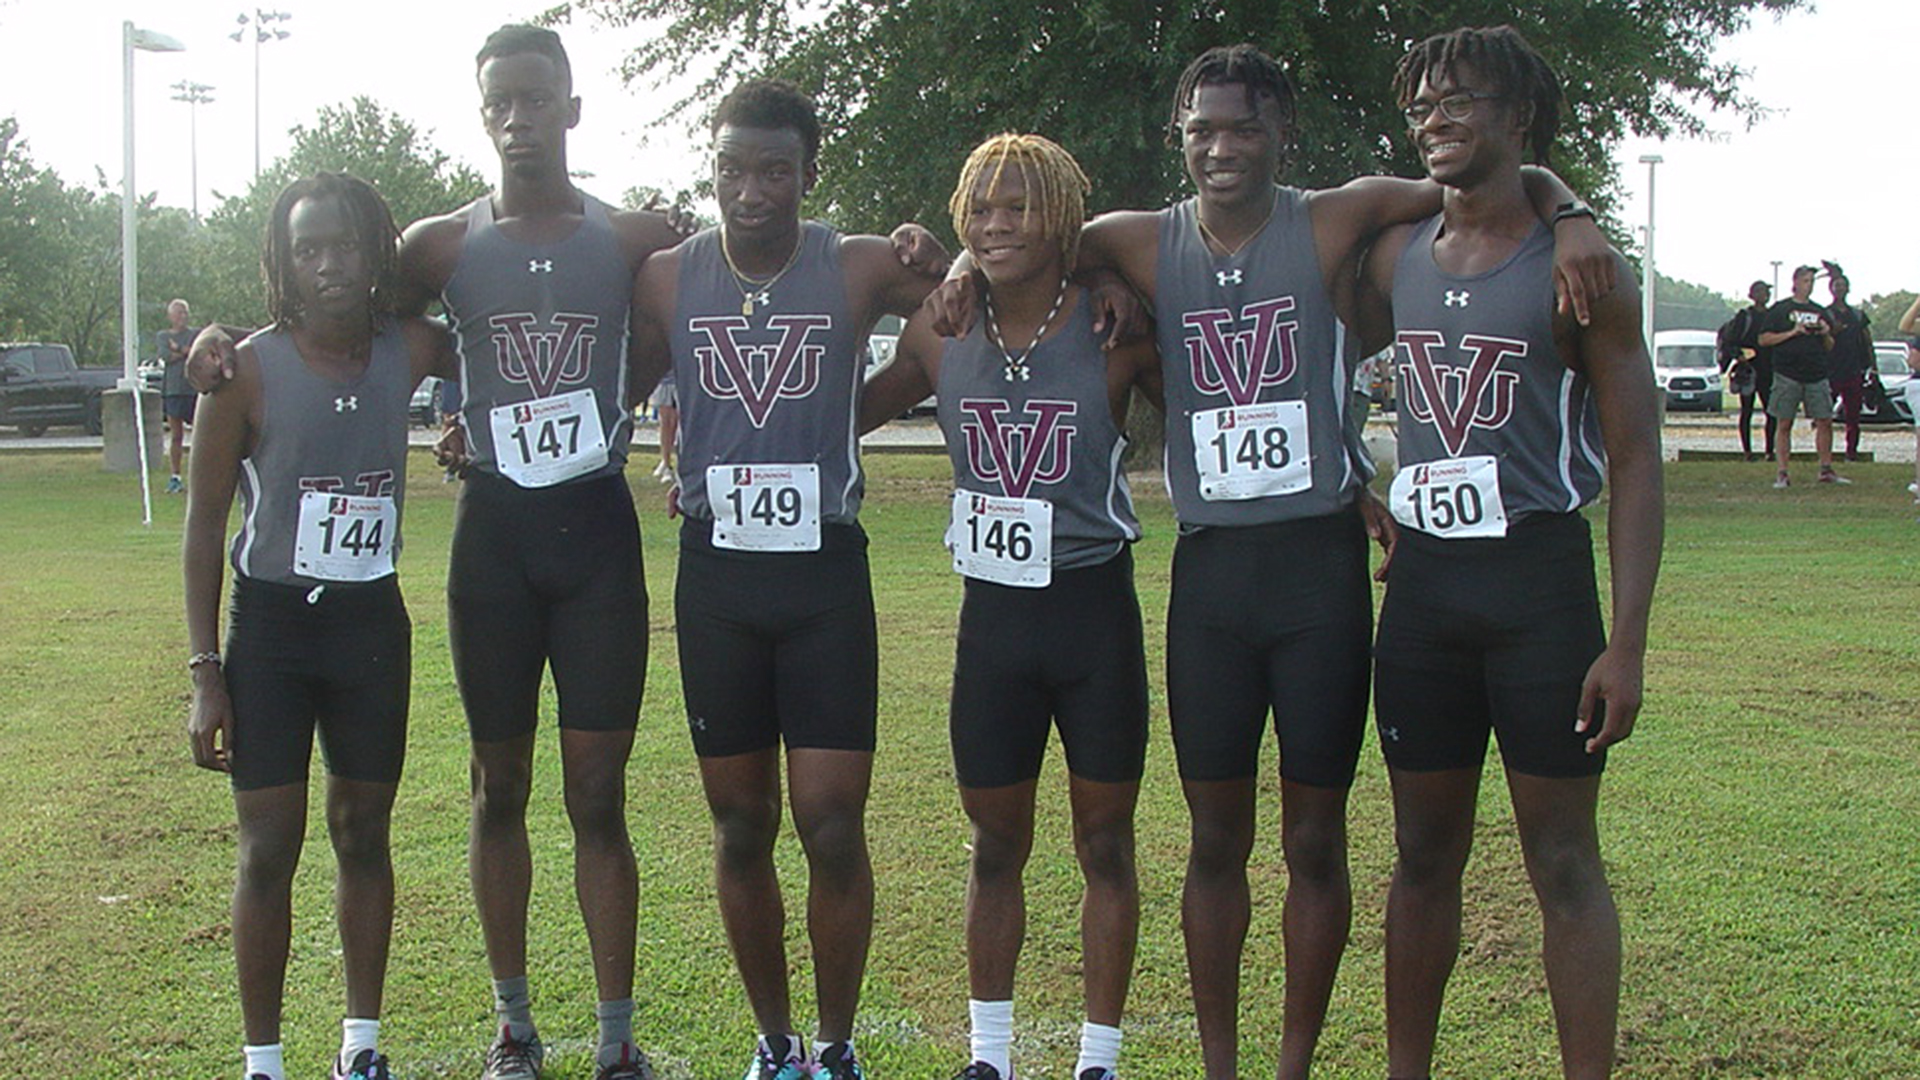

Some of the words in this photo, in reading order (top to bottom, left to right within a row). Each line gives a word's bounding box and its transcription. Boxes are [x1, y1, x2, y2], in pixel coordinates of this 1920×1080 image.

[511, 415, 582, 464] 147
[1211, 427, 1290, 475] 148
[726, 487, 803, 527] 149
[1408, 483, 1483, 529] 150
[318, 516, 384, 556] 144
[967, 515, 1033, 562] 146
